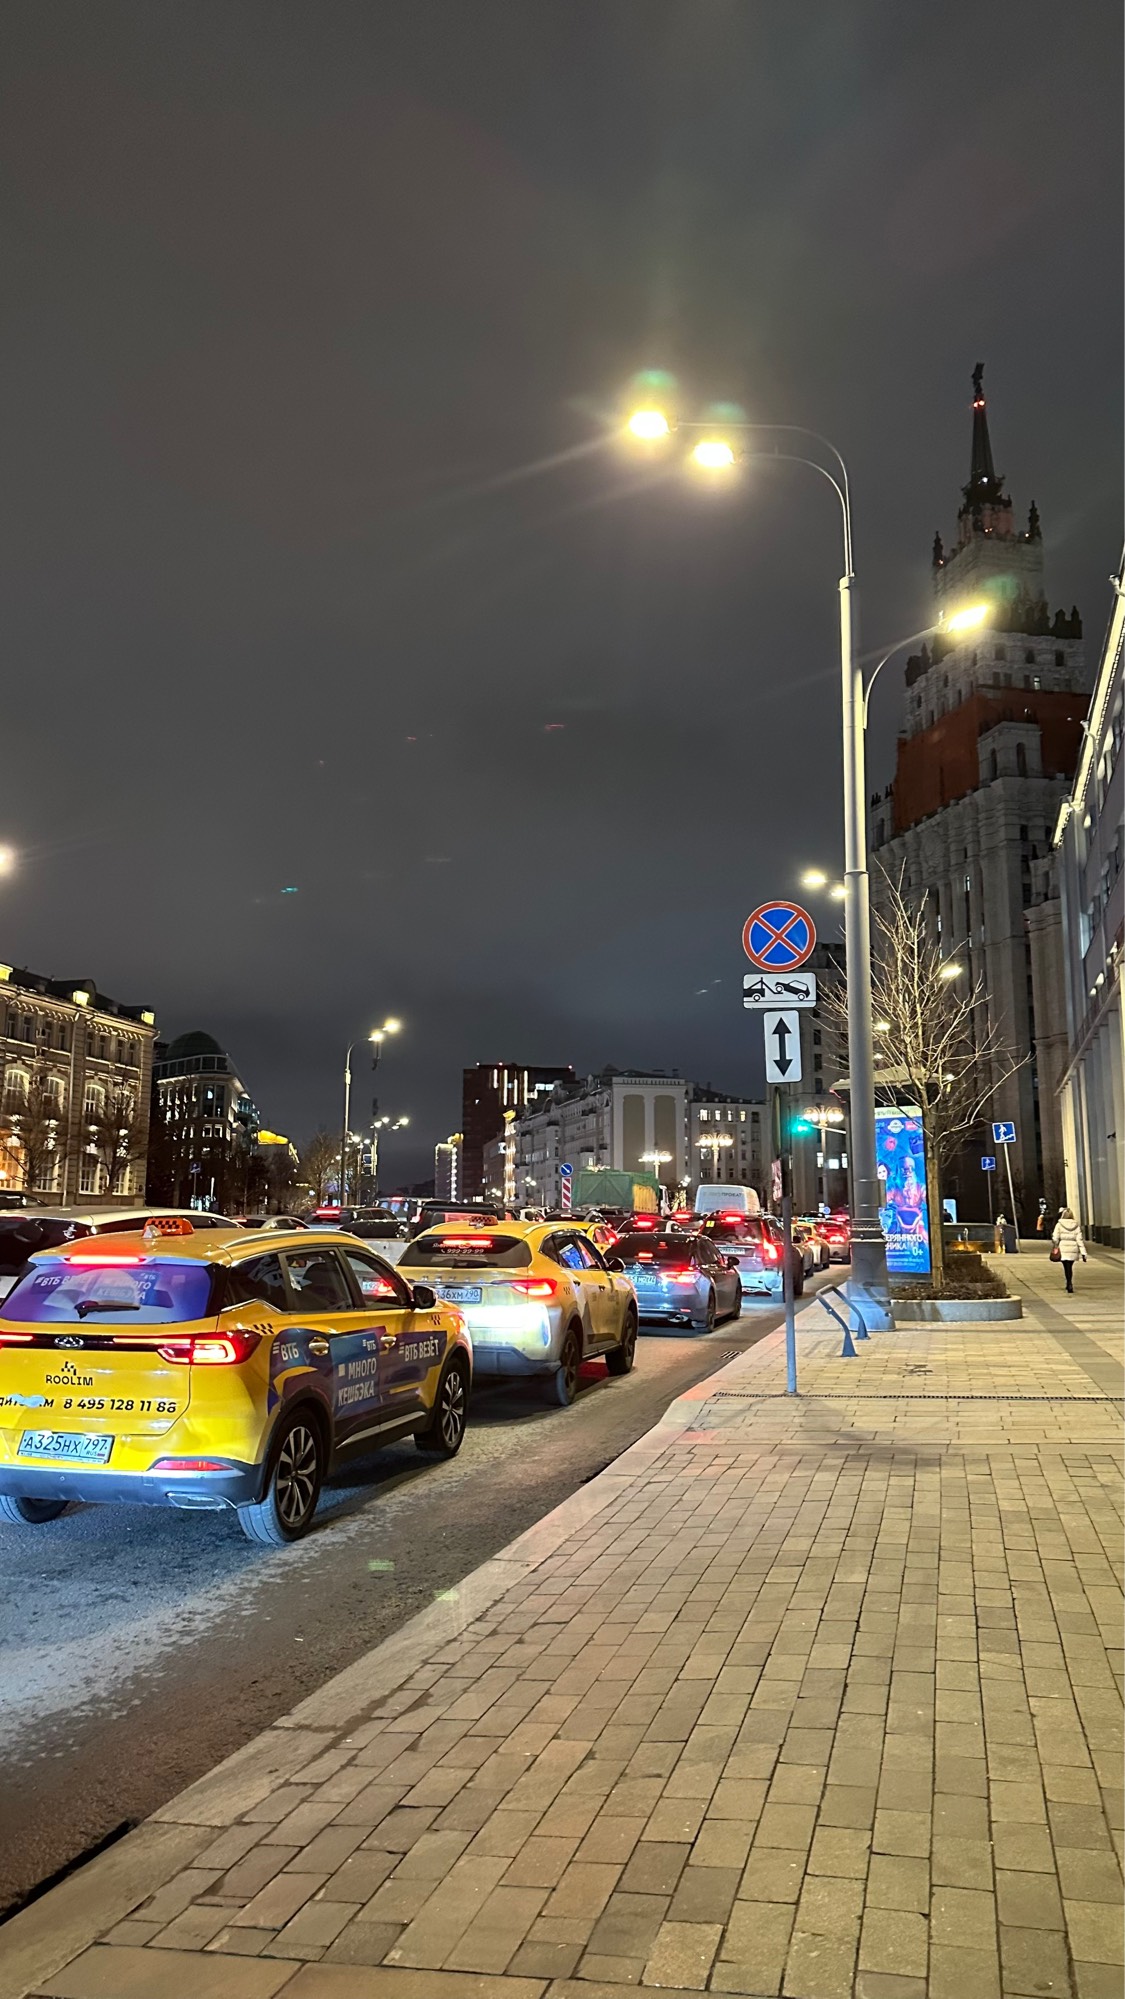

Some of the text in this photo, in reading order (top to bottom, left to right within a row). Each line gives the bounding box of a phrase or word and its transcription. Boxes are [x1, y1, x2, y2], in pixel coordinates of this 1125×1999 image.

[912, 1246, 924, 1256] 0+
[40, 1276, 60, 1287] ВТБ
[280, 1342, 299, 1361] ВТБ
[366, 1340, 376, 1351] ВТБ
[404, 1336, 439, 1362] ВТБ ВЕЗЁТ
[348, 1358, 377, 1379] МНОГО
[45, 1374, 94, 1386] ROOLIM
[338, 1381, 375, 1406] КЕШБЭКА
[63, 1398, 73, 1409] 8
[77, 1399, 105, 1410] 495
[110, 1399, 134, 1411] 128
[140, 1400, 151, 1412] 11
[156, 1401, 177, 1413] 88
[25, 1434, 107, 1454] А325НХ 797
